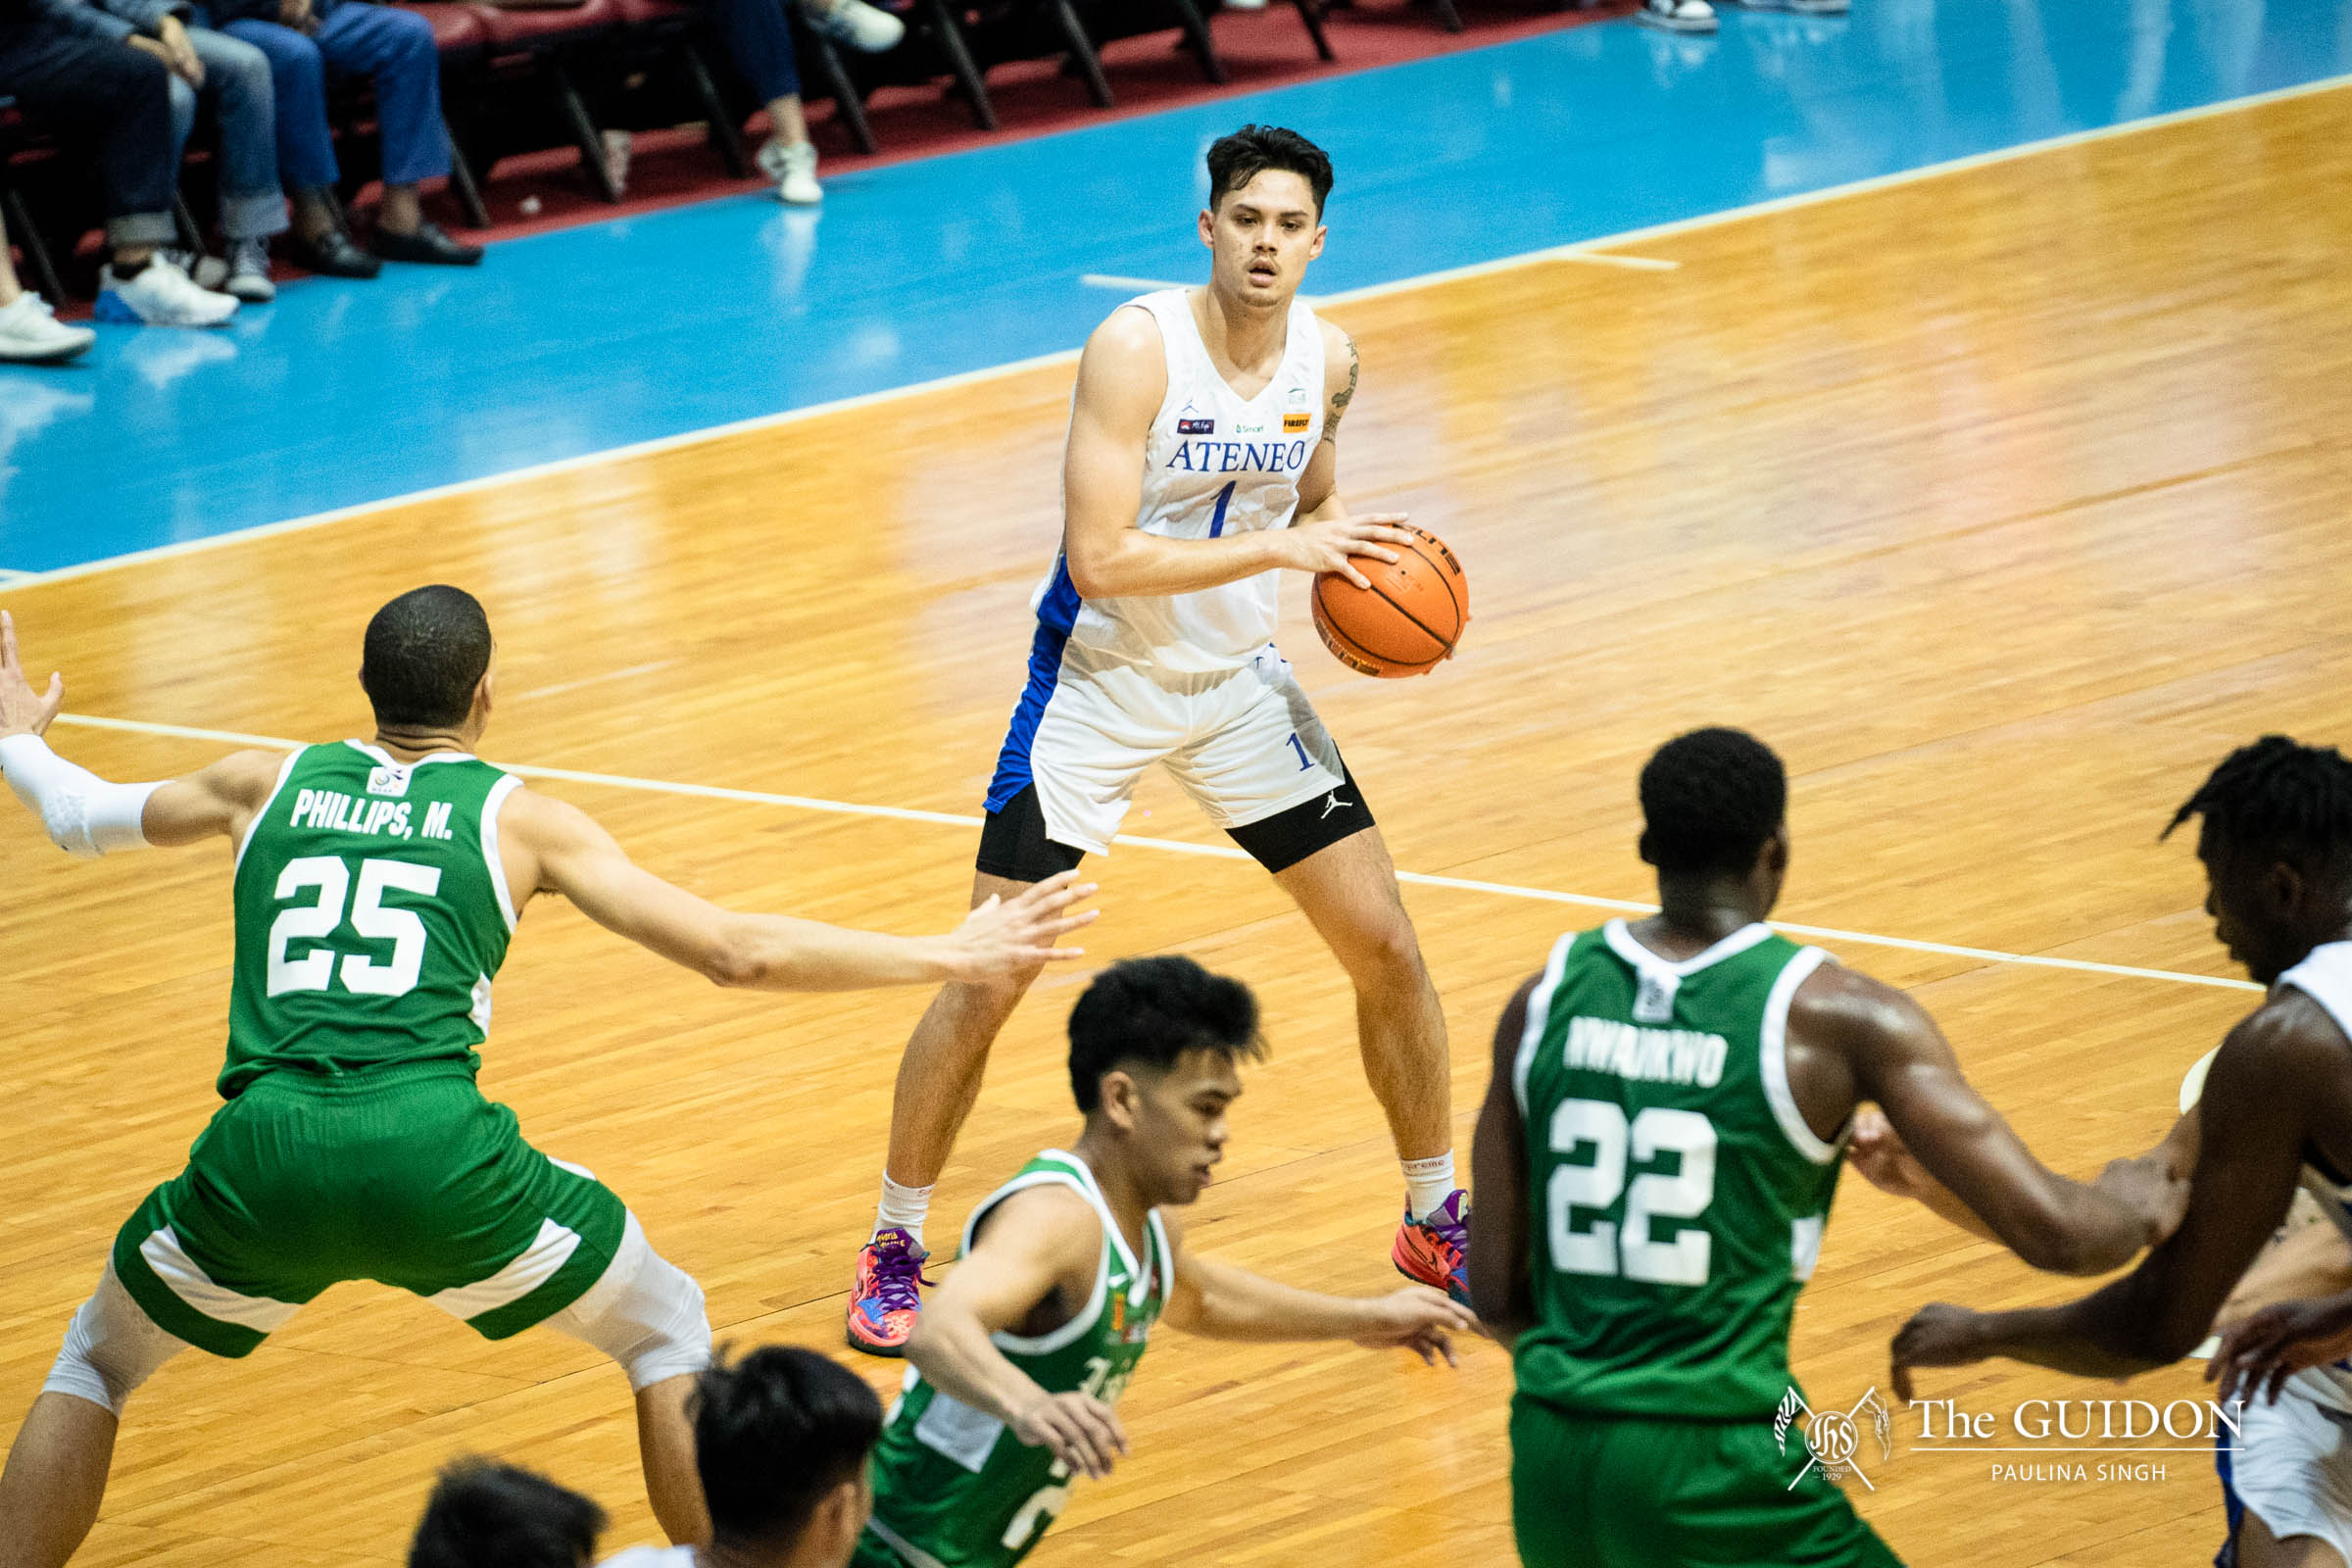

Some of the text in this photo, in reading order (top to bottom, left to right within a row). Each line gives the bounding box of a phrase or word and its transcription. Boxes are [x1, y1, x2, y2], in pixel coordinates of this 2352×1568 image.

[1166, 439, 1305, 472] ATENEO
[1209, 480, 1237, 538] 1
[1286, 732, 1315, 771] 1
[290, 789, 453, 840] PHILLIPS, M.
[267, 856, 441, 998] 25
[1546, 1097, 1718, 1287] 22
